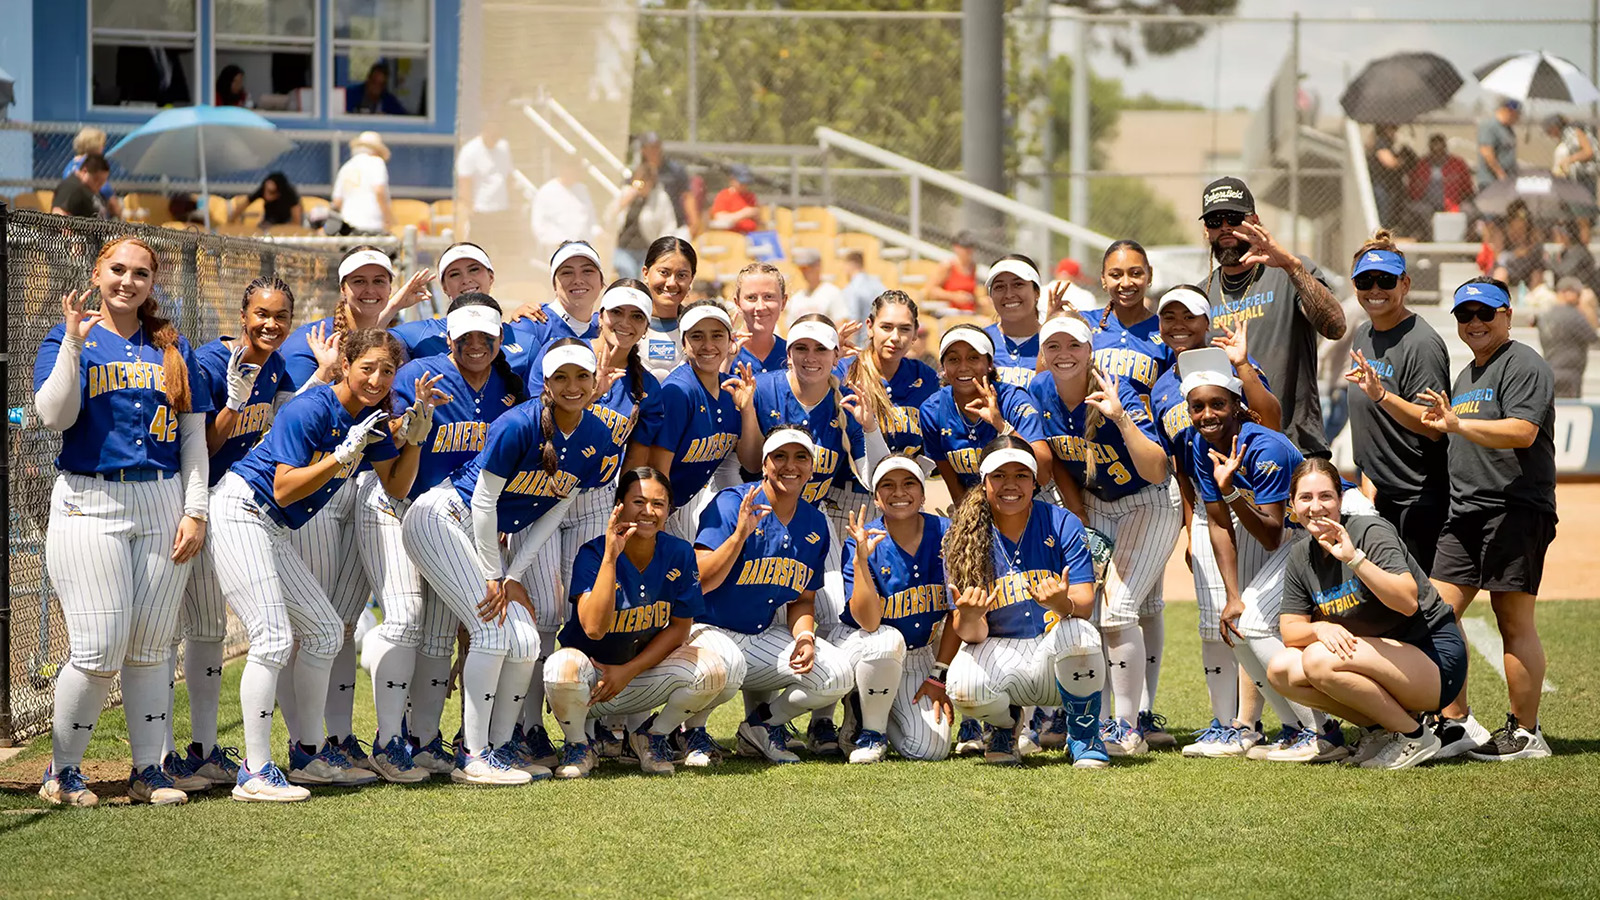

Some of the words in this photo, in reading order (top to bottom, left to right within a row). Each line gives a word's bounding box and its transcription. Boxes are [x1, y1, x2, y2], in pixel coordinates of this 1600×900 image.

[1204, 190, 1244, 206] Bakersfield
[1210, 290, 1274, 319] AKERSFIELD
[89, 361, 167, 399] BAKERSFIE
[149, 405, 179, 443] 42
[431, 421, 491, 453] BAKERS
[1107, 461, 1132, 485] 3
[1318, 592, 1360, 617] OFTBALL
